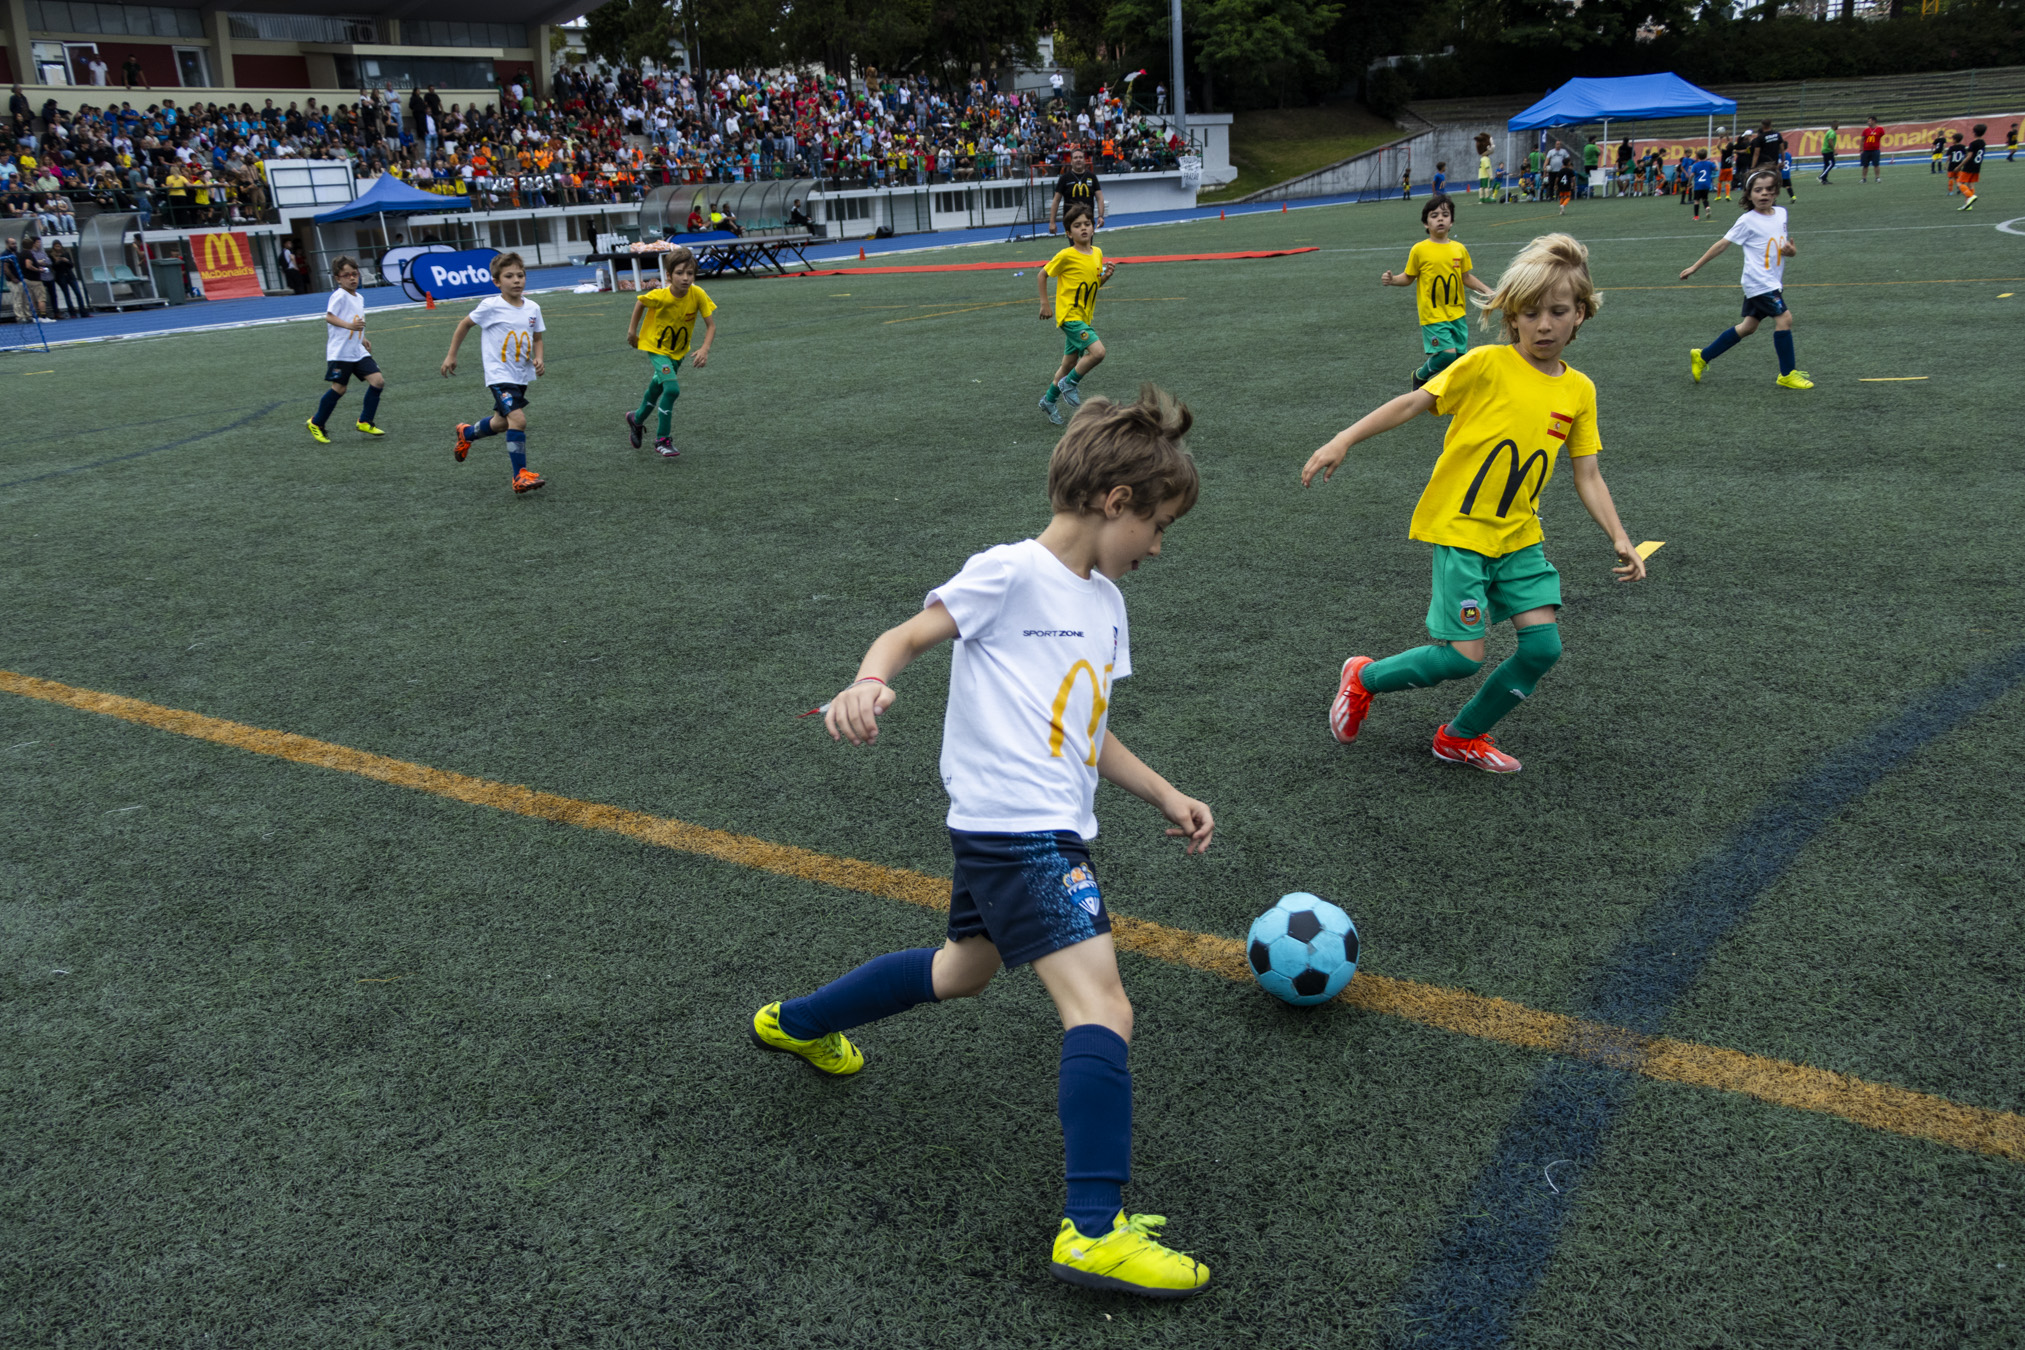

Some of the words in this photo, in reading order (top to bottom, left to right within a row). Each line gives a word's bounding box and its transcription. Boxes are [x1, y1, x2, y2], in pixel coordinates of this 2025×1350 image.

[1834, 127, 1957, 150] Mconald's
[1952, 150, 1963, 162] 10
[1560, 174, 1568, 185] 4
[1698, 169, 1707, 182] 2
[201, 266, 254, 280] McDonald's
